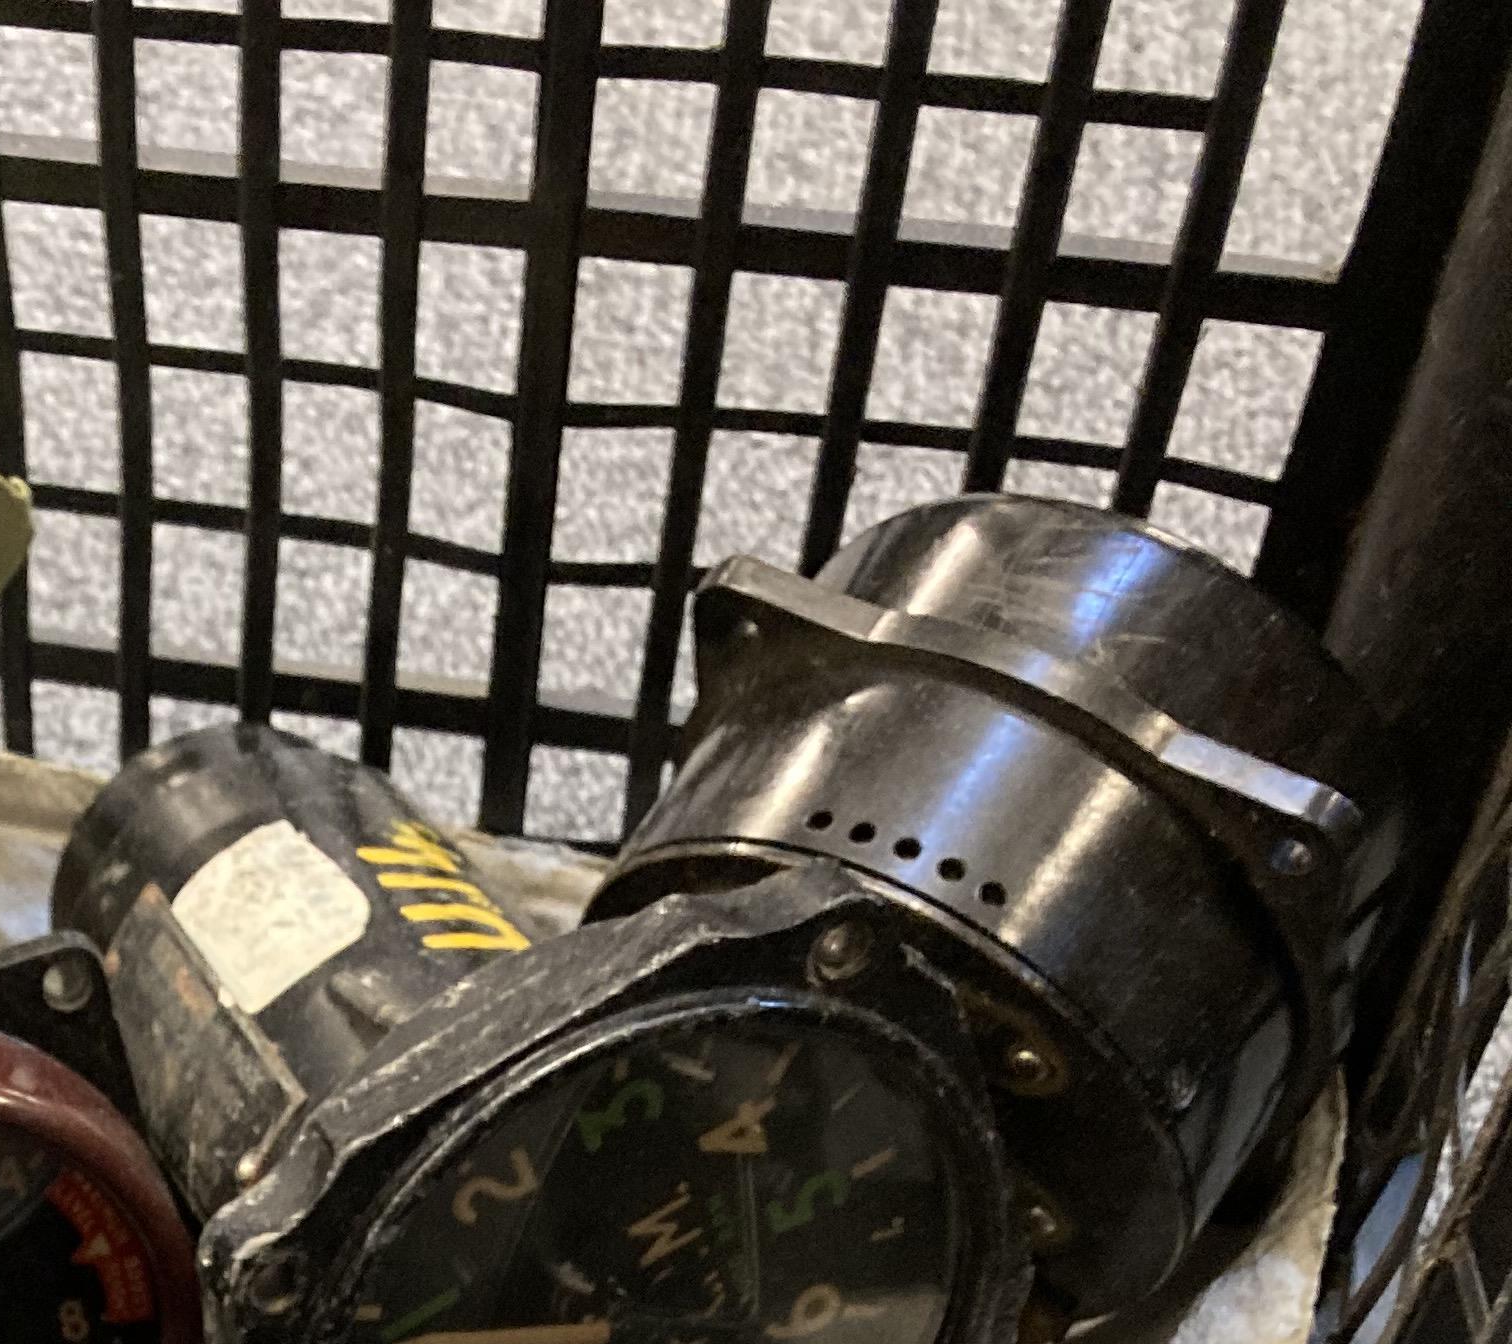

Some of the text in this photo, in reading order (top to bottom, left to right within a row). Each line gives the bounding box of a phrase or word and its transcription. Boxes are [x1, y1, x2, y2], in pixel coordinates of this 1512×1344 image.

[576, 1078, 665, 1154] 3
[699, 1097, 776, 1155] 4
[452, 1147, 538, 1227] 2
[767, 1169, 850, 1234] 5
[58, 1298, 90, 1343] 8
